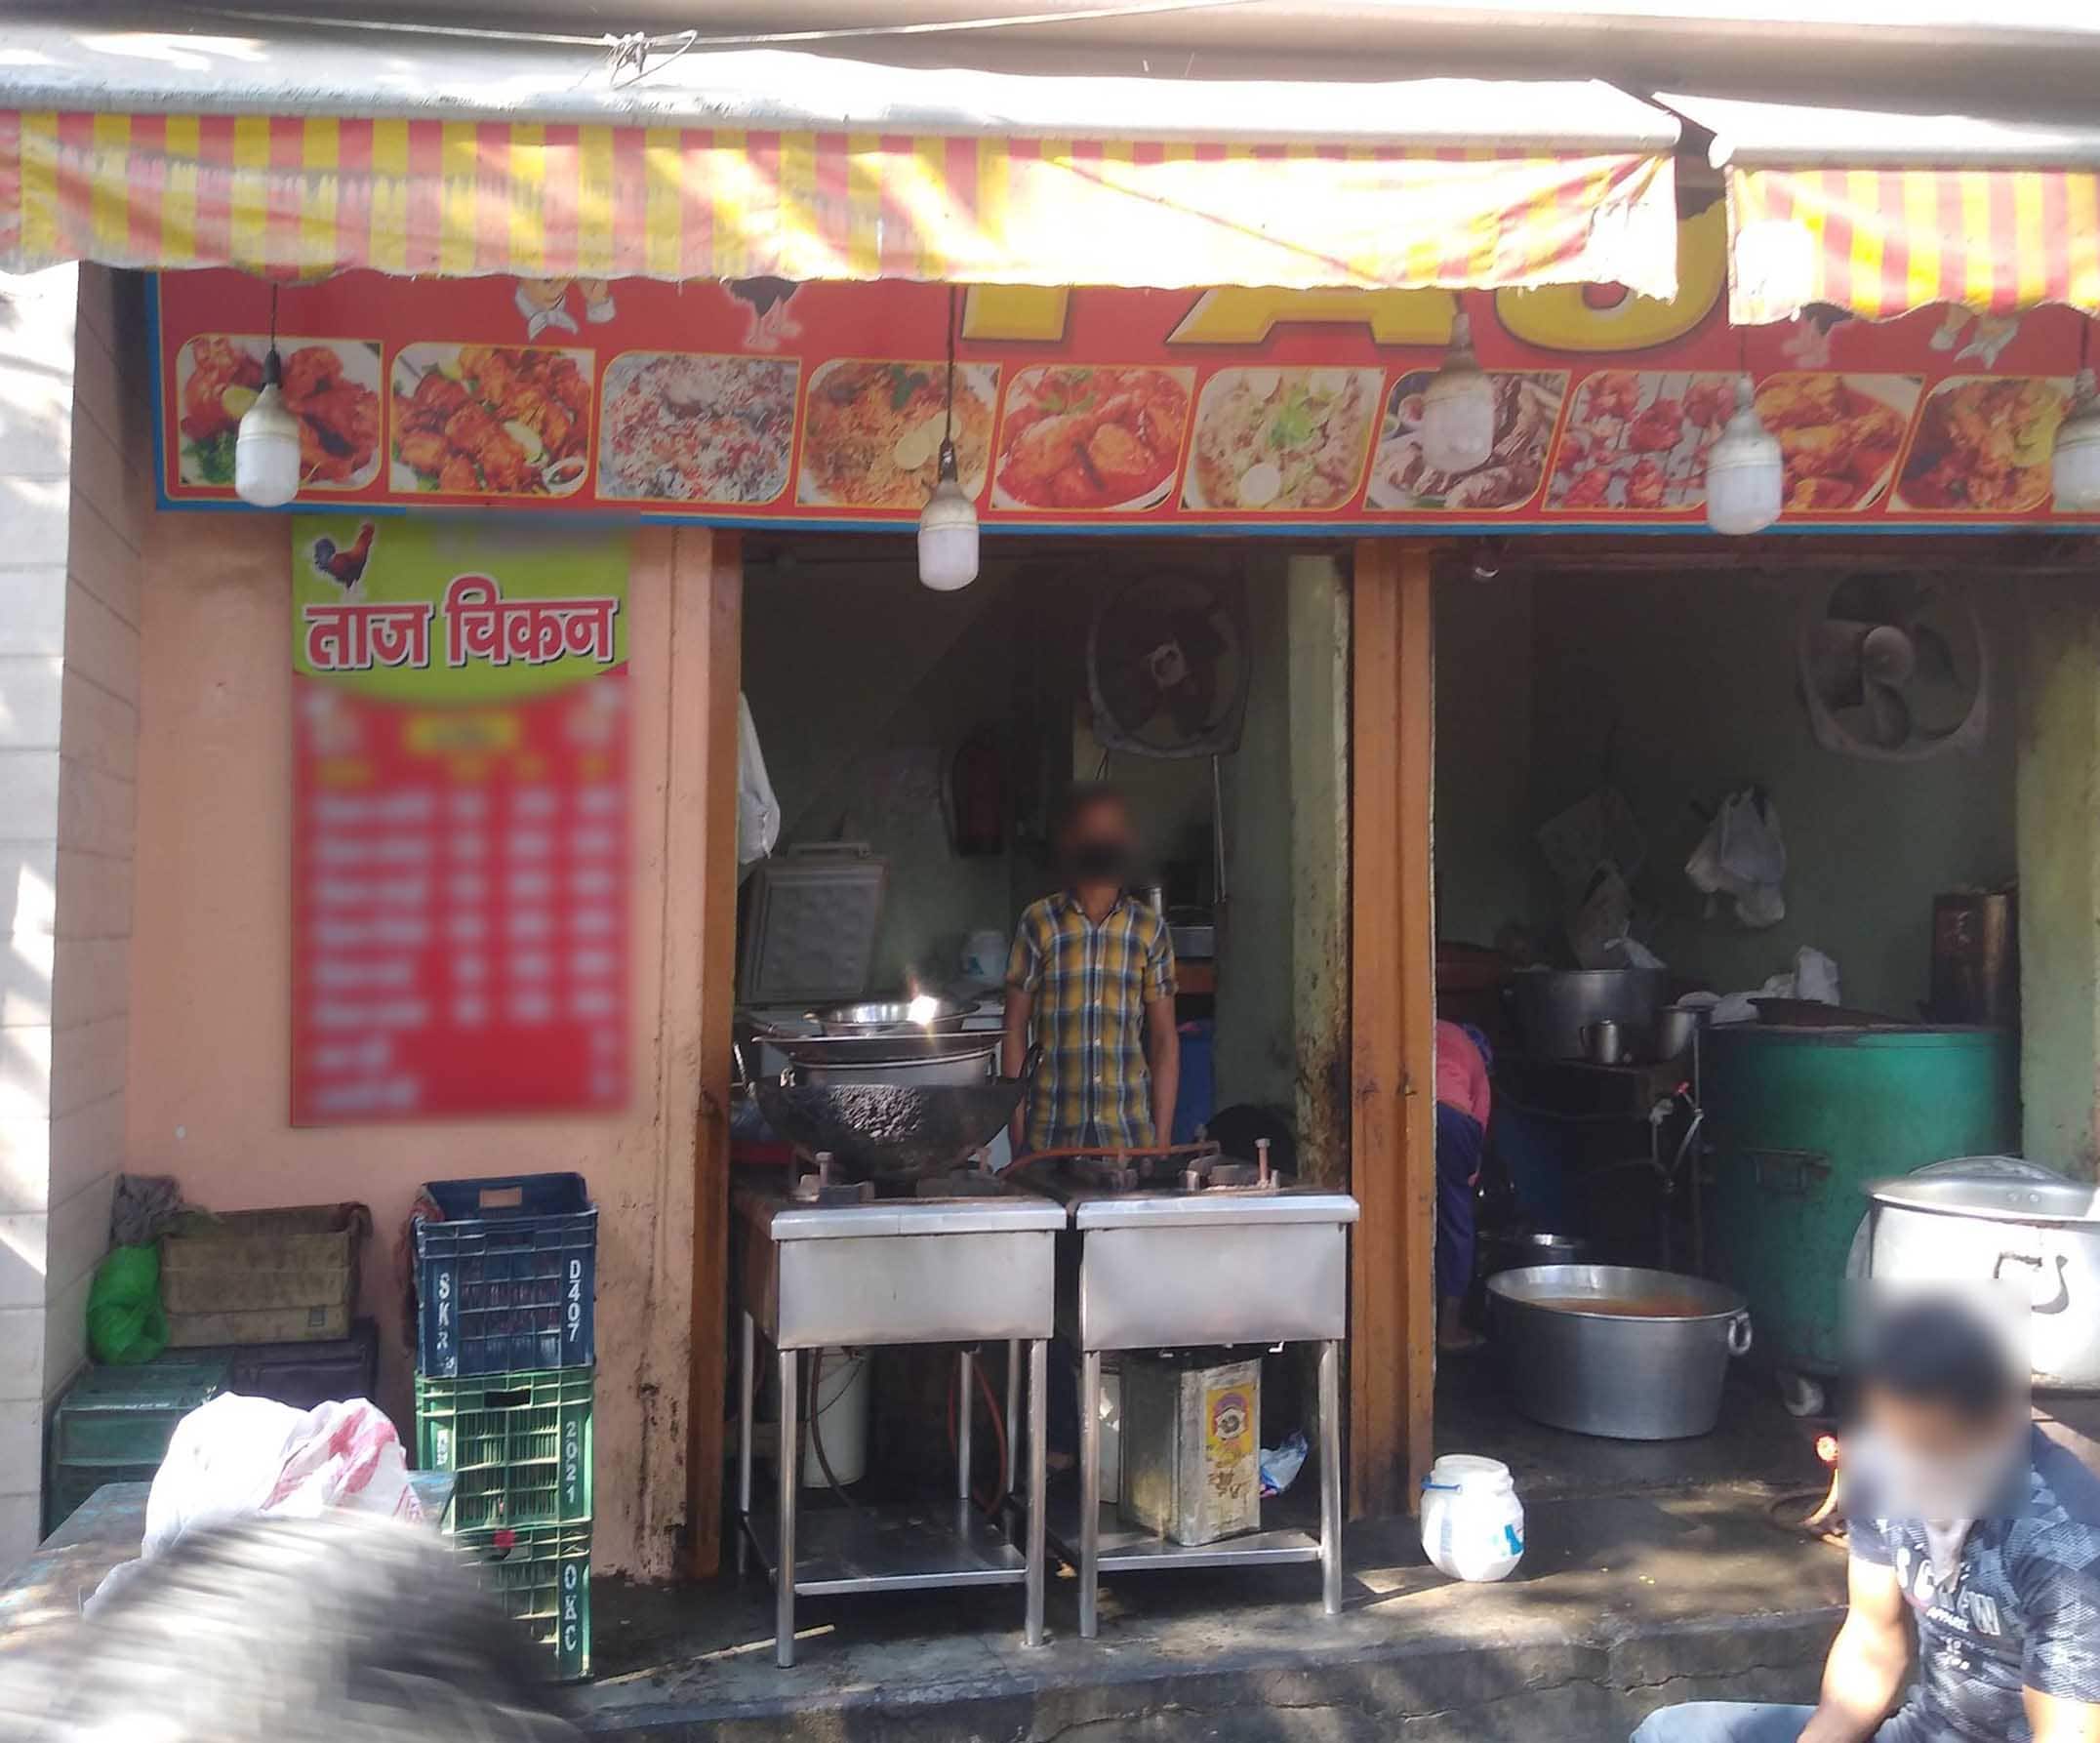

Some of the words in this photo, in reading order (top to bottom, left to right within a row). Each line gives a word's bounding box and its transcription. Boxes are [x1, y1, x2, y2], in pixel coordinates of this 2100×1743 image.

[304, 601, 433, 669] ताज
[444, 574, 619, 666] चिकन
[567, 1259, 582, 1343] D407
[565, 1420, 579, 1504] 2021
